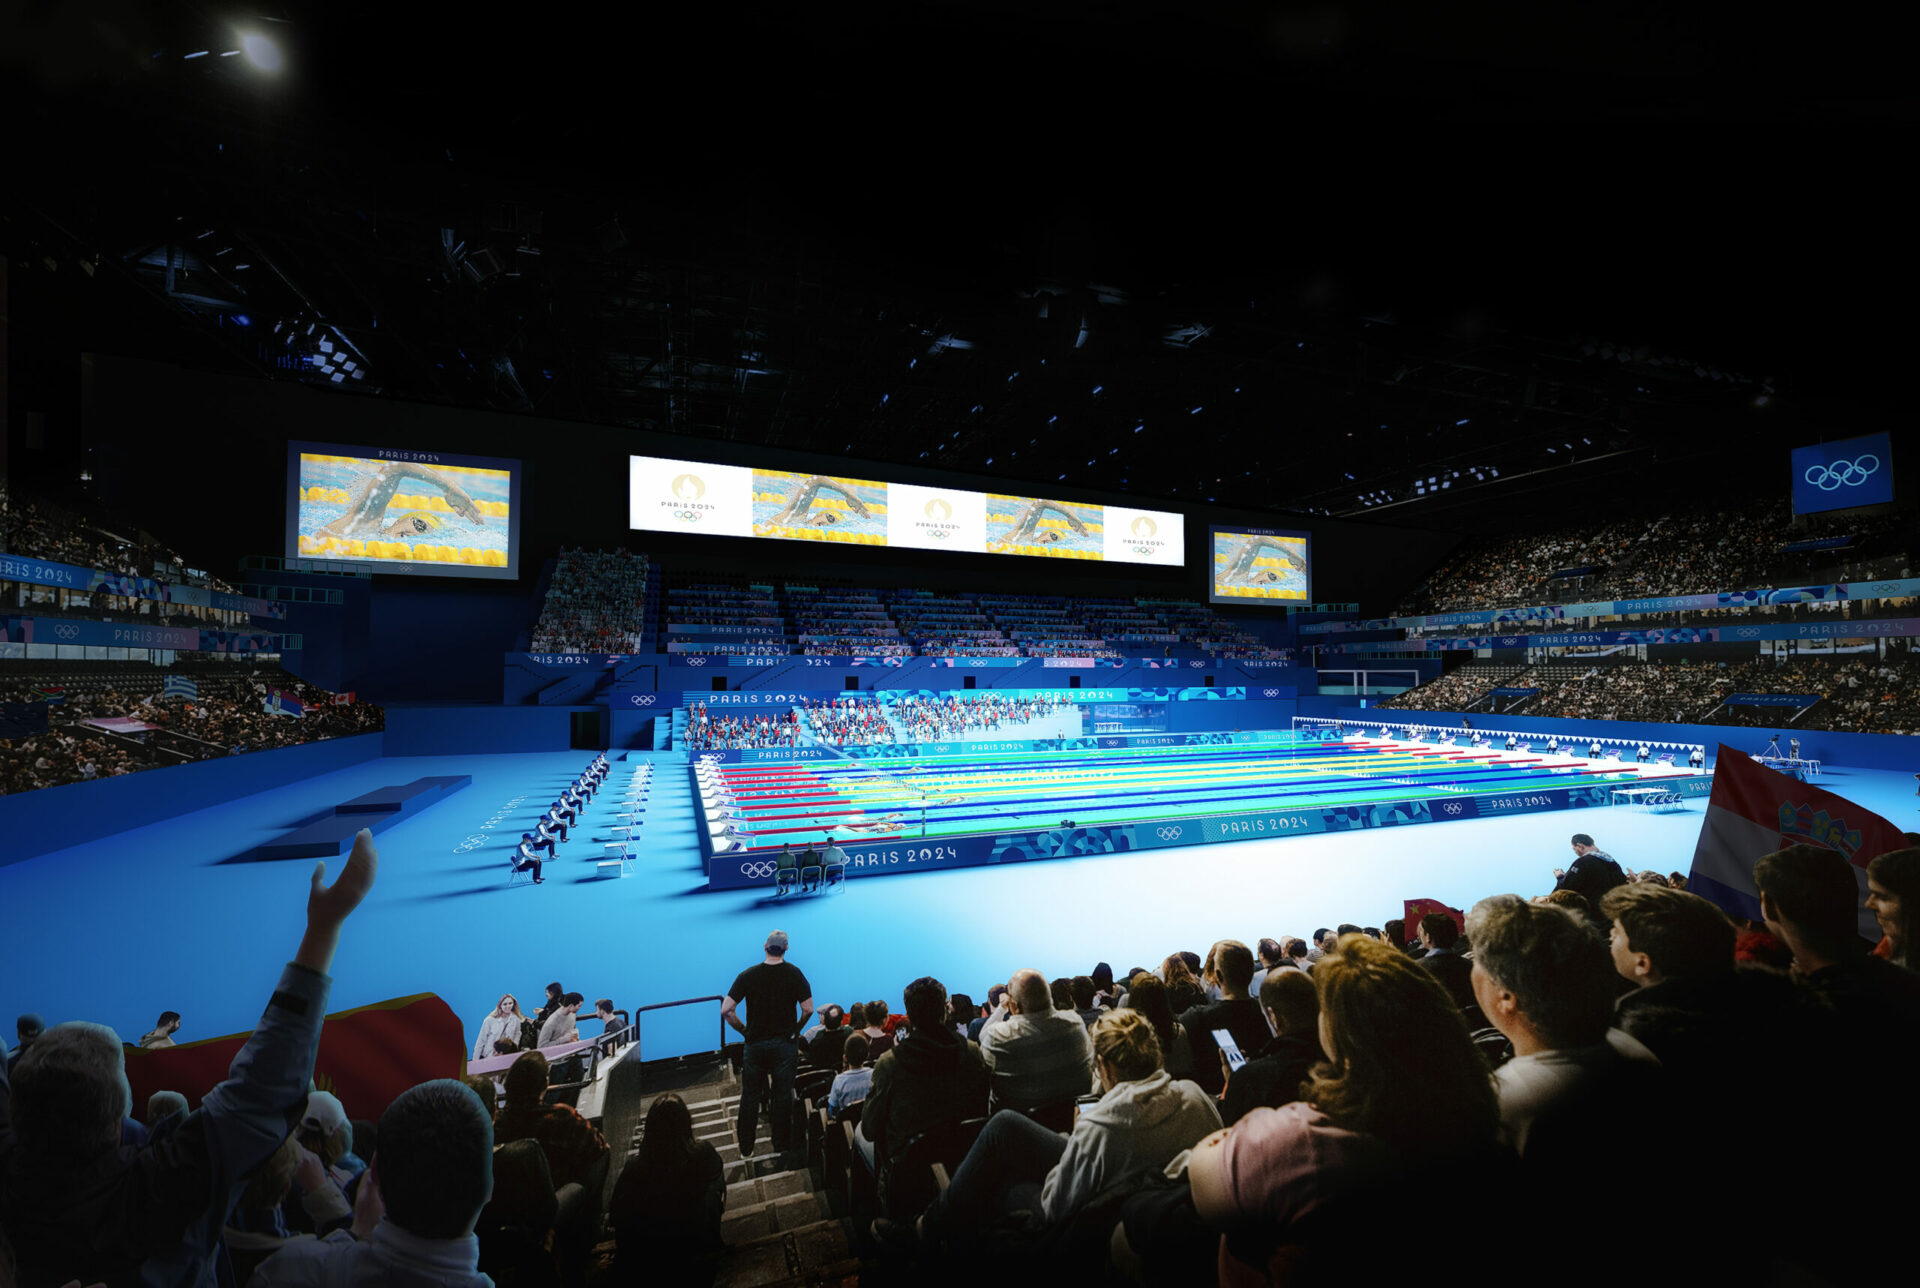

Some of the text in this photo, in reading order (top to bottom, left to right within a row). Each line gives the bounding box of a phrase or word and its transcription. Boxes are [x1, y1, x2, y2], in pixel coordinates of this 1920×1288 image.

[378, 450, 440, 462] PARIS 2024
[0, 560, 72, 584] RIS 2024
[1627, 601, 1662, 611] PARIS
[712, 626, 774, 635] PARIS 2024
[1800, 623, 1904, 636] PARIS 2024
[114, 629, 187, 645] PARIS 2024
[1539, 635, 1601, 644] PARIS 2024
[557, 655, 589, 664] 2024
[746, 658, 787, 666] PARI
[709, 694, 807, 703] PARIS 2024
[1079, 691, 1113, 700] 2024
[758, 750, 822, 759] PARIS 2024
[1491, 796, 1552, 809] PARIS 2024
[1221, 816, 1308, 835] PARIS 2024
[907, 846, 956, 862] 2024
